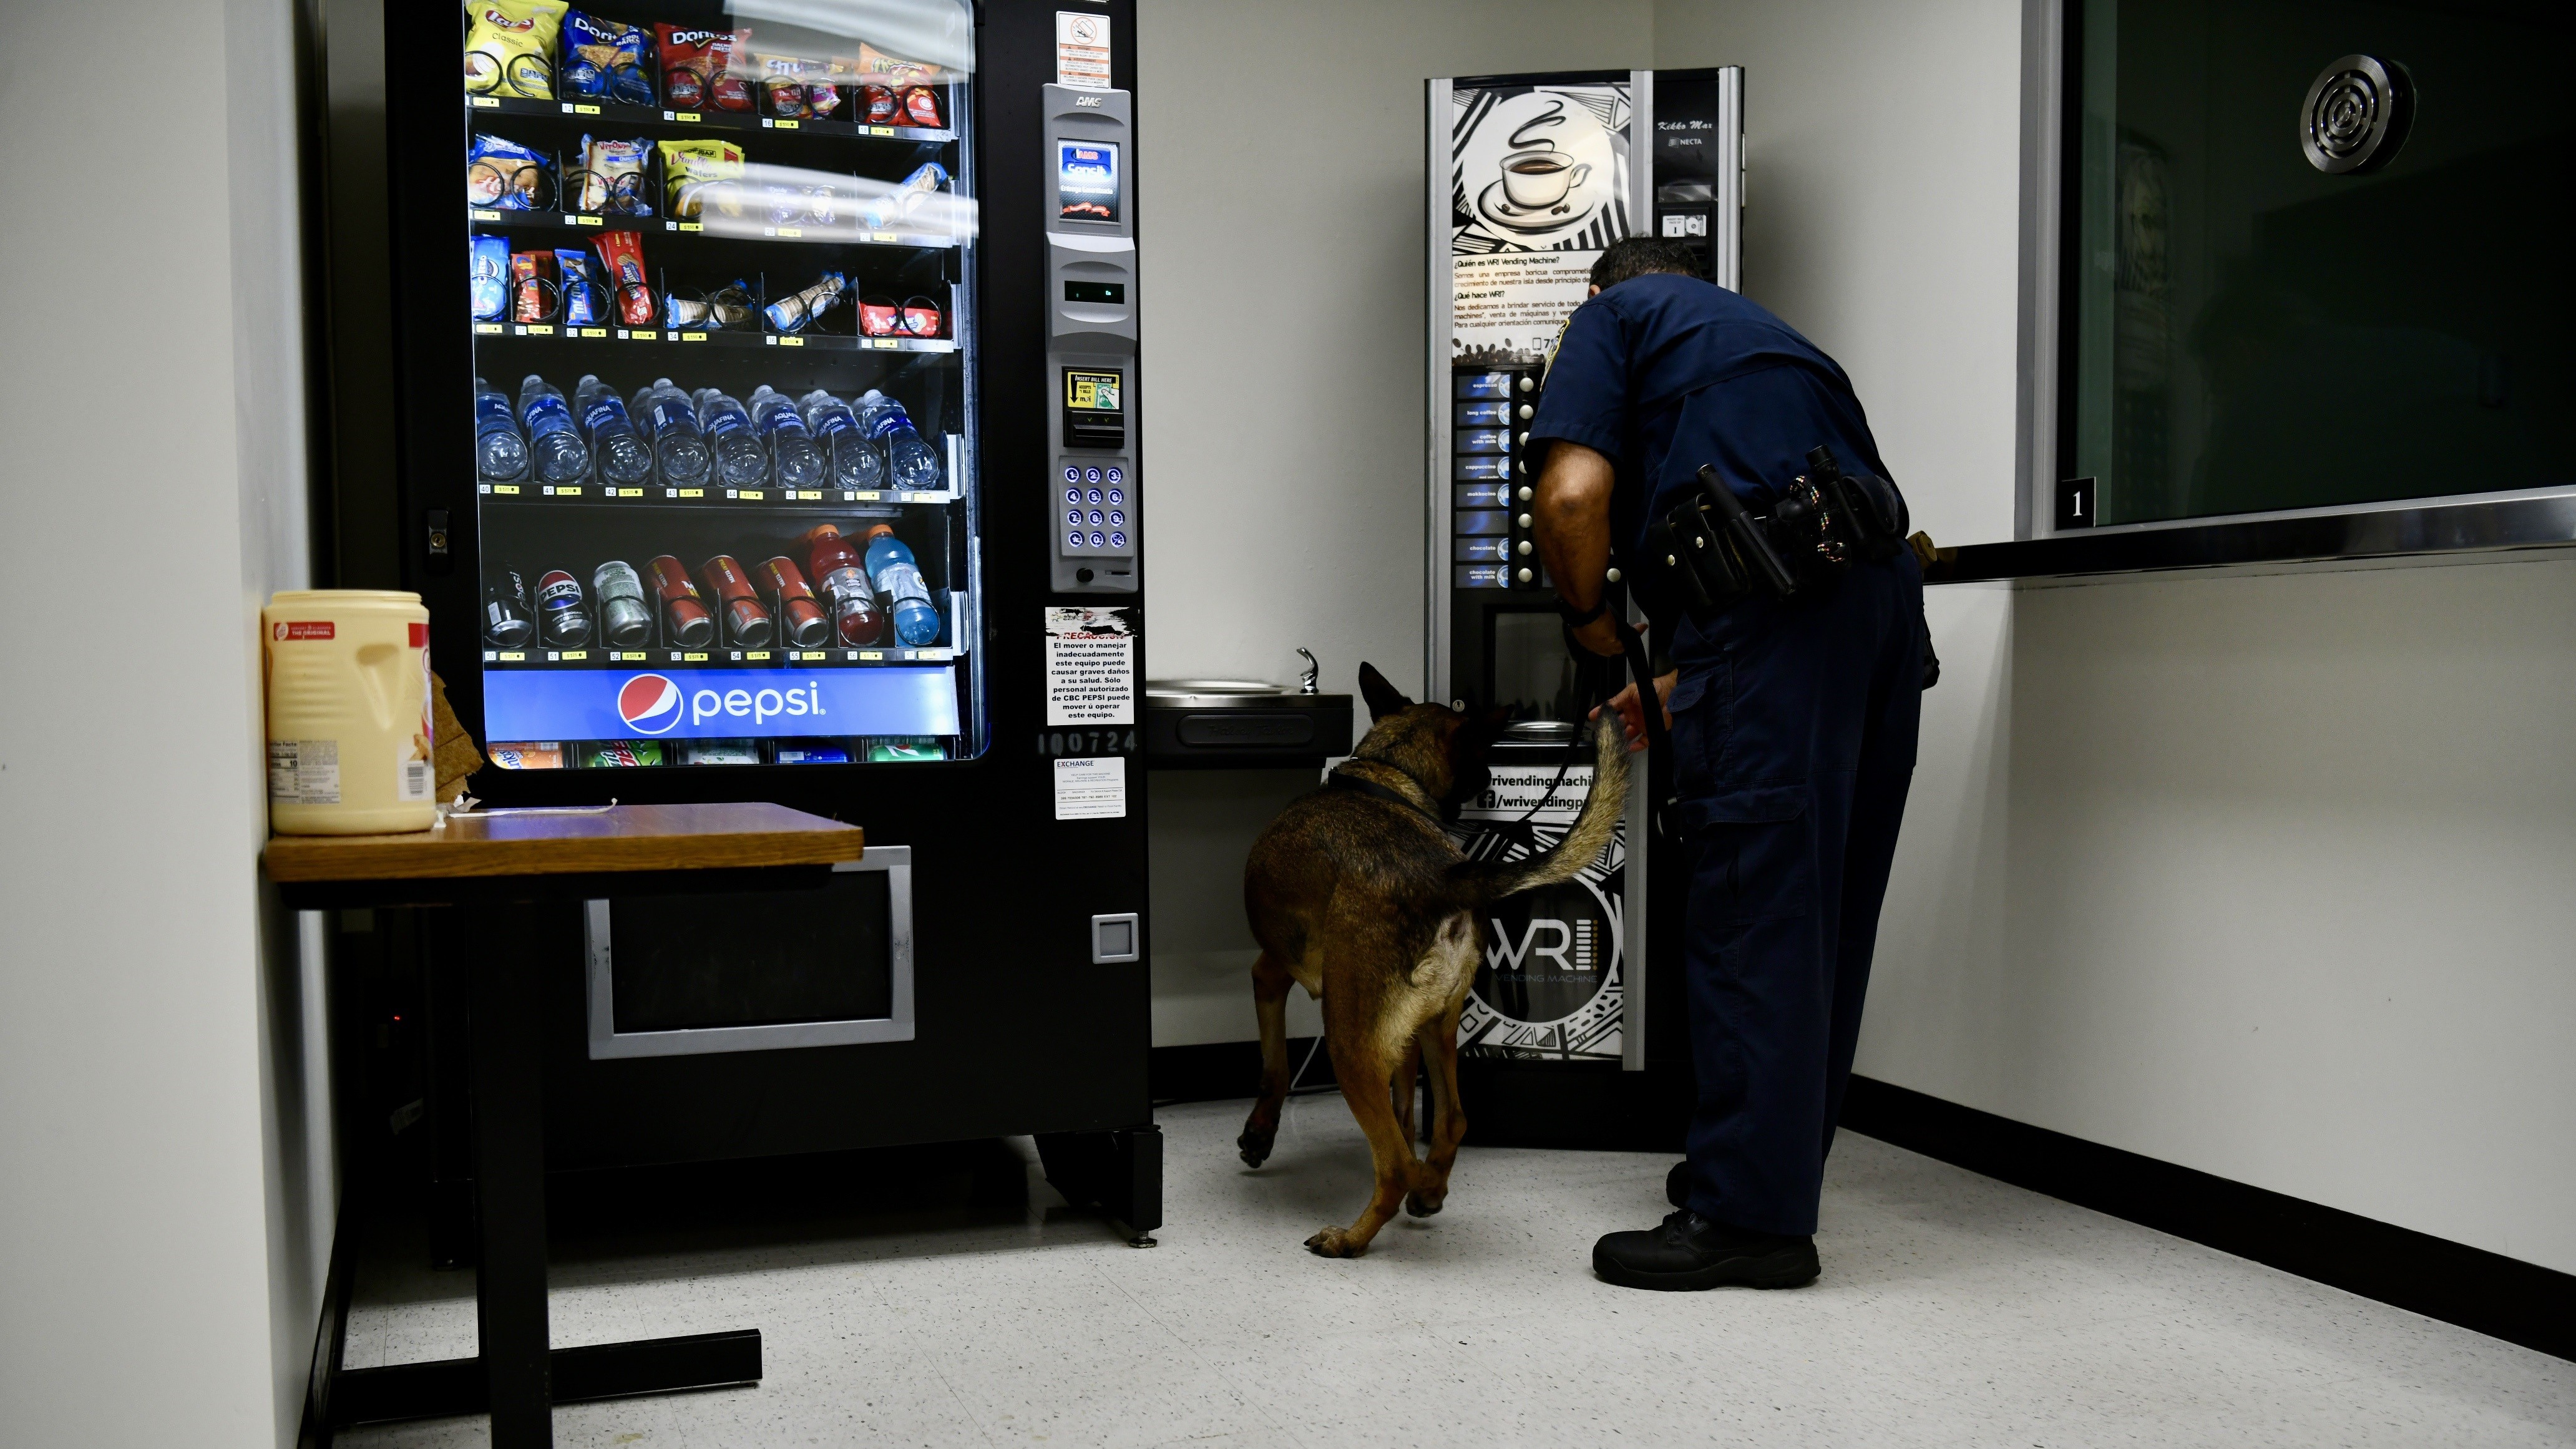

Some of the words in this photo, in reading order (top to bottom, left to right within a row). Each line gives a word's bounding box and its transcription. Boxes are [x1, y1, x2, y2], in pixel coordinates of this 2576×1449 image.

[492, 32, 523, 47] Classic
[1076, 97, 1101, 108] AMS
[1658, 121, 1686, 130] Kikko
[1690, 120, 1712, 130] Max
[671, 152, 712, 170] Vanilla
[1078, 151, 1098, 160] AMS
[1455, 260, 1476, 268] ¿Quién
[1501, 258, 1527, 266] Vending
[1529, 256, 1559, 265] Machine?
[1555, 276, 1581, 285] principio
[1455, 291, 1470, 301] ¿Qué
[1520, 310, 1549, 318] máquinas
[2073, 491, 2082, 516] 1
[540, 584, 580, 602] PEPSI
[1075, 660, 1100, 668] equipo
[1103, 660, 1125, 668] puede
[693, 681, 819, 726] pepsi
[1038, 730, 1136, 756] 100724
[1491, 775, 1594, 789] rivendingachi
[1496, 795, 1586, 809] /wrivedingp
[1495, 974, 1544, 982] VENDING
[1547, 975, 1598, 983] MACHINE
